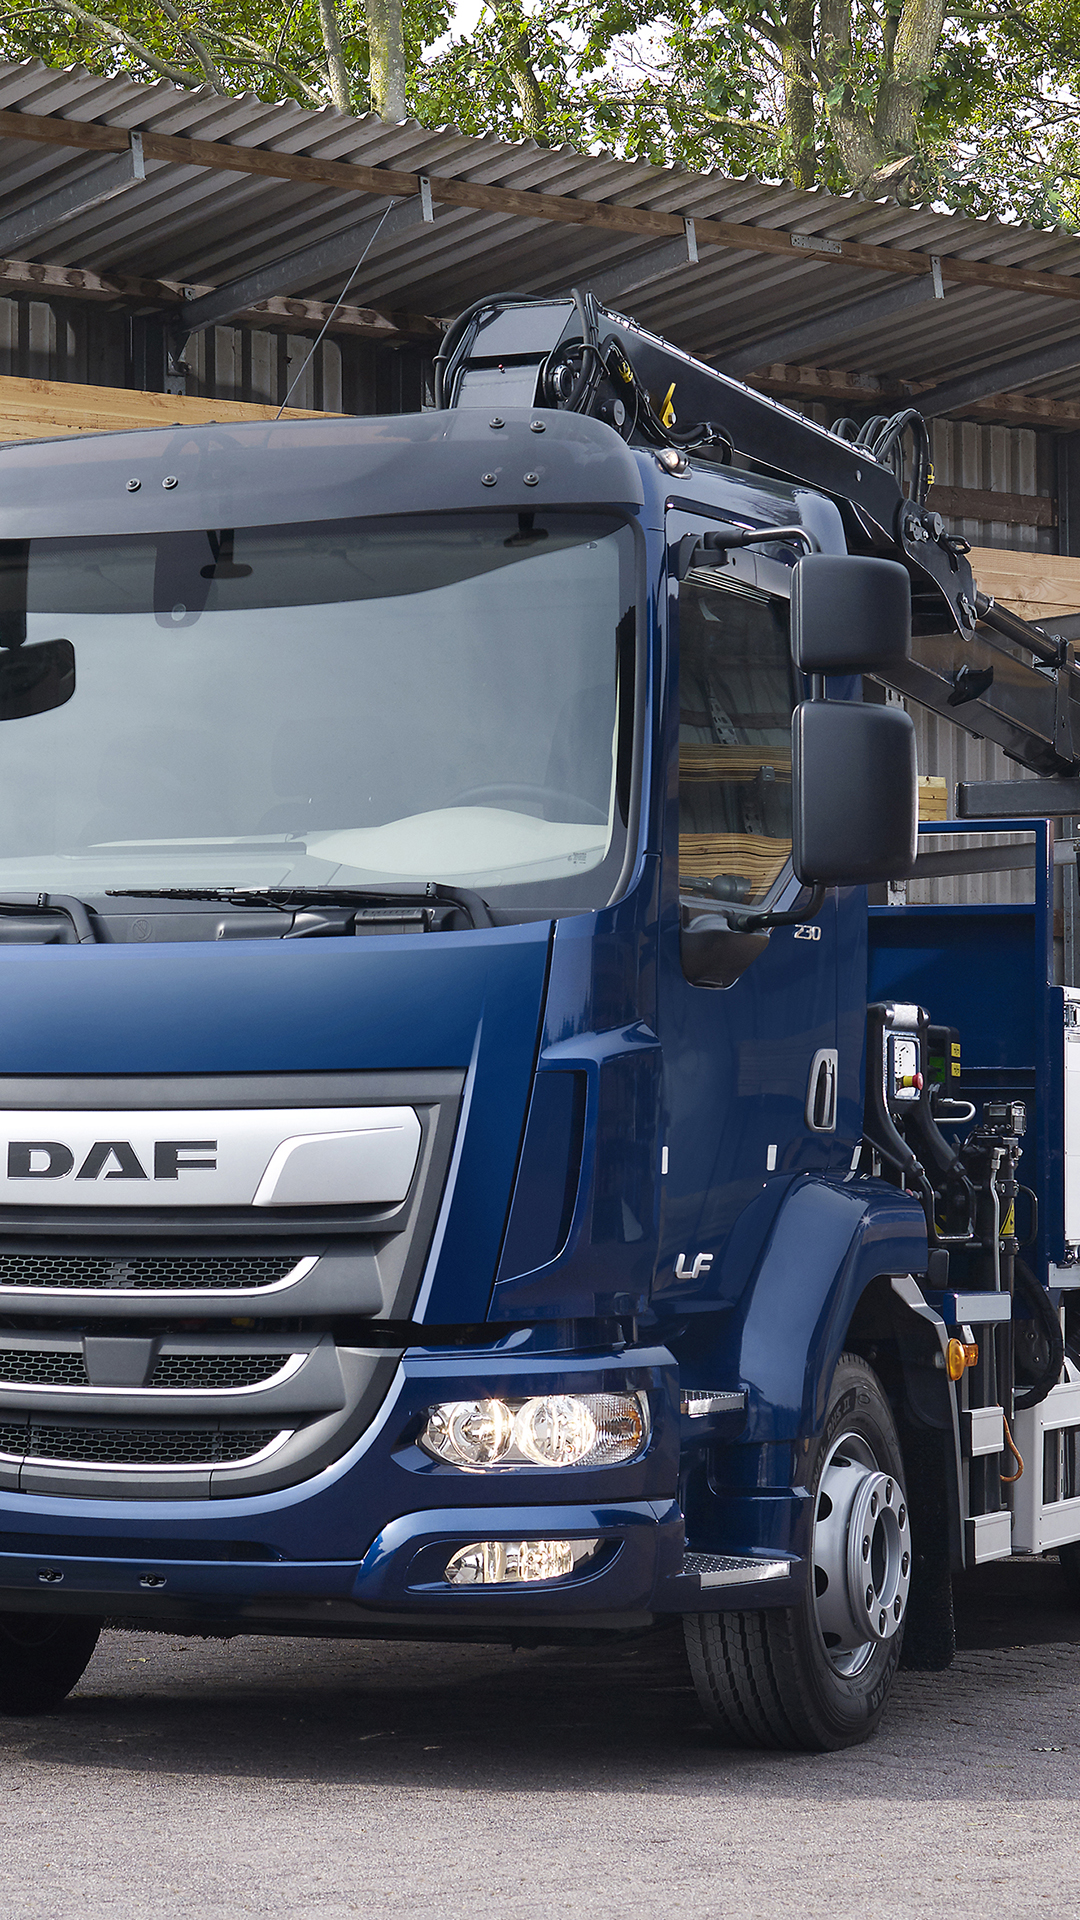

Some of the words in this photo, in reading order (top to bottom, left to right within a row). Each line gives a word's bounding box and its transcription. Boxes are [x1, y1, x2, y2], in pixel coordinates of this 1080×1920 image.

[794, 924, 821, 941] 230
[7, 1139, 218, 1181] DAF
[675, 1252, 714, 1279] LF
